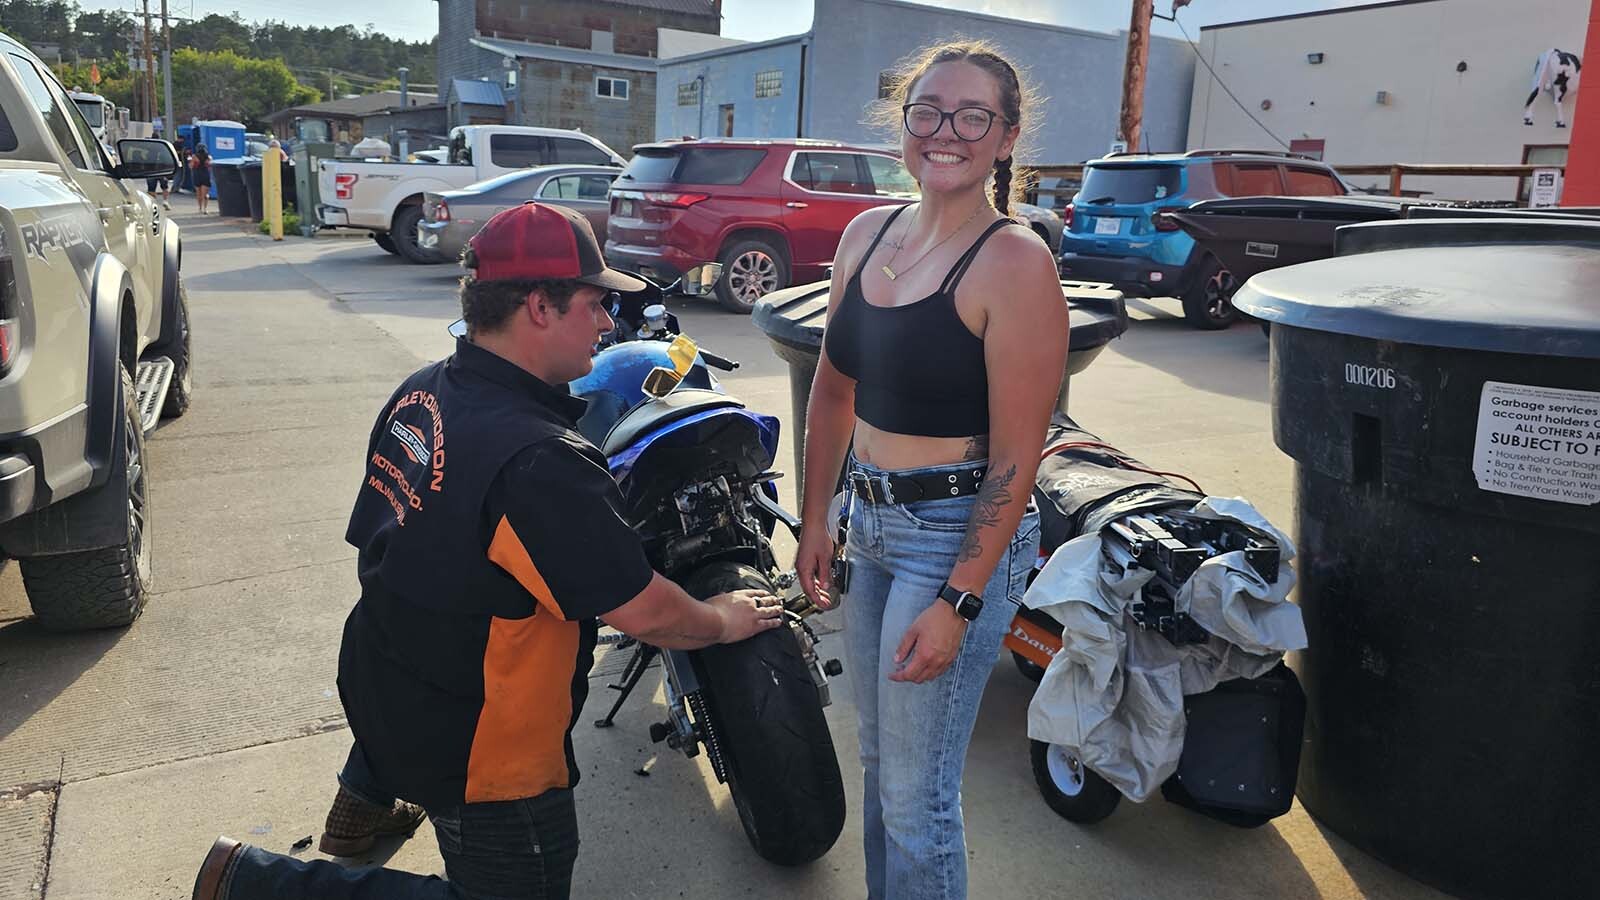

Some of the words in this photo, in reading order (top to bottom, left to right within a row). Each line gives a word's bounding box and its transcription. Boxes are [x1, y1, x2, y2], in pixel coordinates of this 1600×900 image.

[1345, 362, 1396, 389] 000206
[1491, 396, 1545, 411] Garbage
[1548, 405, 1598, 416] services
[1492, 409, 1542, 422] account
[1545, 415, 1590, 428] holders
[386, 390, 445, 492] RLEY-DAVIDSON
[1515, 423, 1535, 434] ALL
[1538, 426, 1582, 439] OTHERS
[1490, 432, 1561, 452] SUBJECT
[1566, 441, 1588, 455] TO
[1495, 450, 1550, 464] Household
[1493, 469, 1508, 478] No
[1510, 471, 1576, 488] Construction
[1494, 459, 1515, 471] Bag
[1518, 463, 1525, 471] &
[1528, 464, 1542, 473] Tie
[1545, 466, 1568, 477] Your
[1571, 469, 1597, 480] Trash
[1492, 478, 1507, 488] No
[1509, 481, 1560, 496] Tree/Yard
[1562, 488, 1595, 500] Waste
